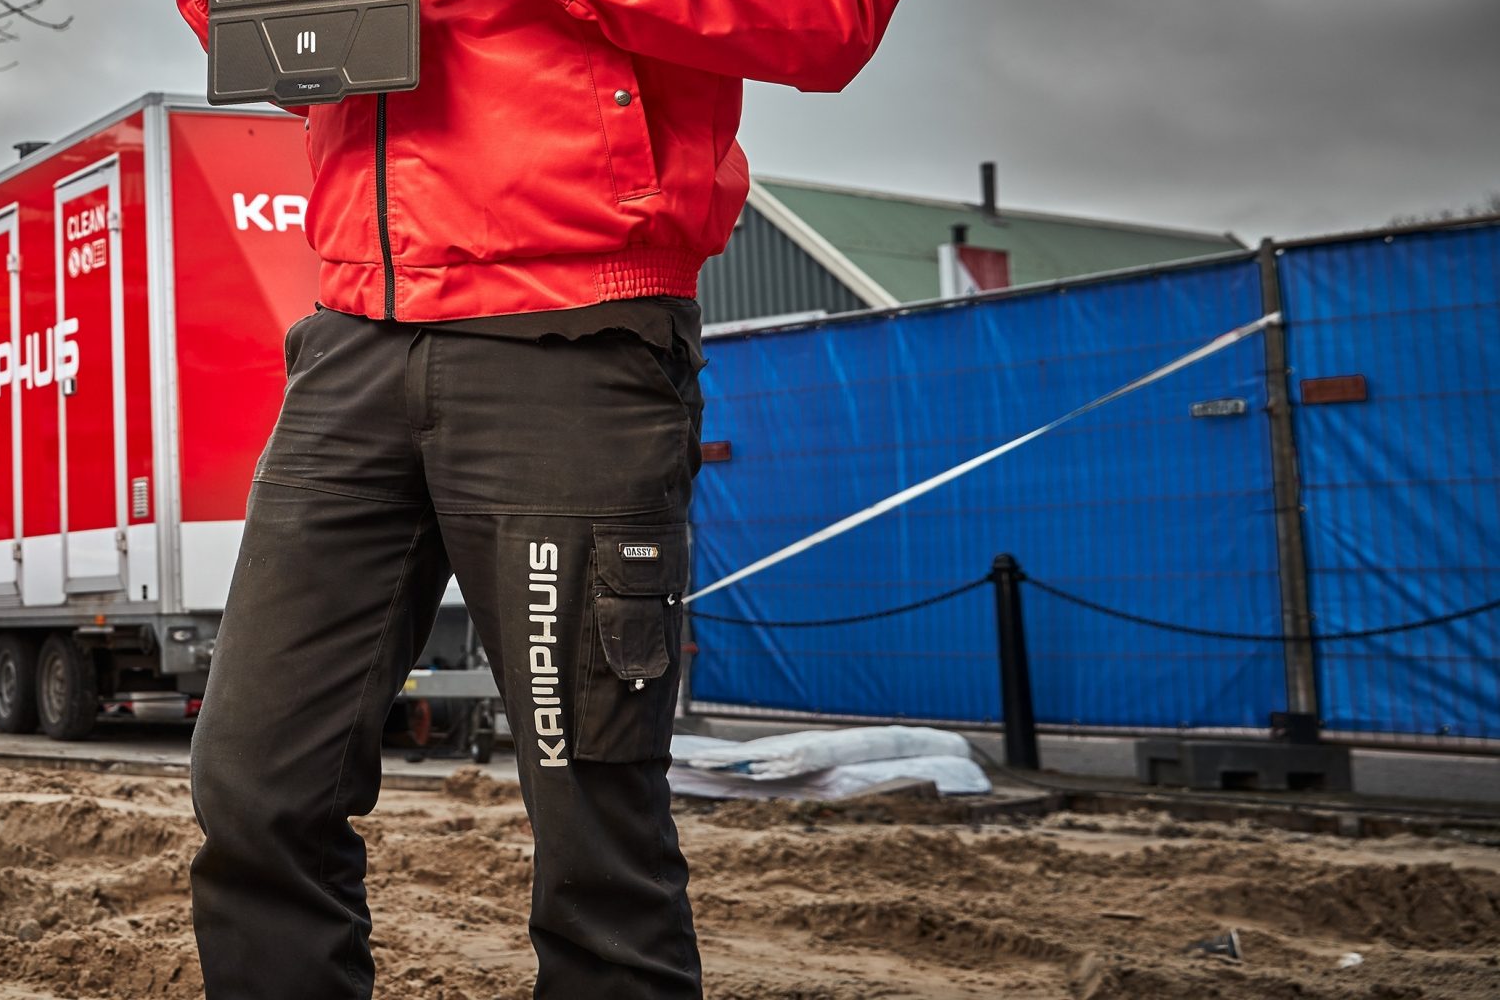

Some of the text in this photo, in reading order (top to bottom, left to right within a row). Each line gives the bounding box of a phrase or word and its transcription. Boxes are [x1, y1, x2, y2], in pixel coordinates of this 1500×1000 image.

[67, 204, 106, 241] CLEAN
[626, 547, 651, 556] DASSY
[528, 542, 568, 767] KAMPHUIS
